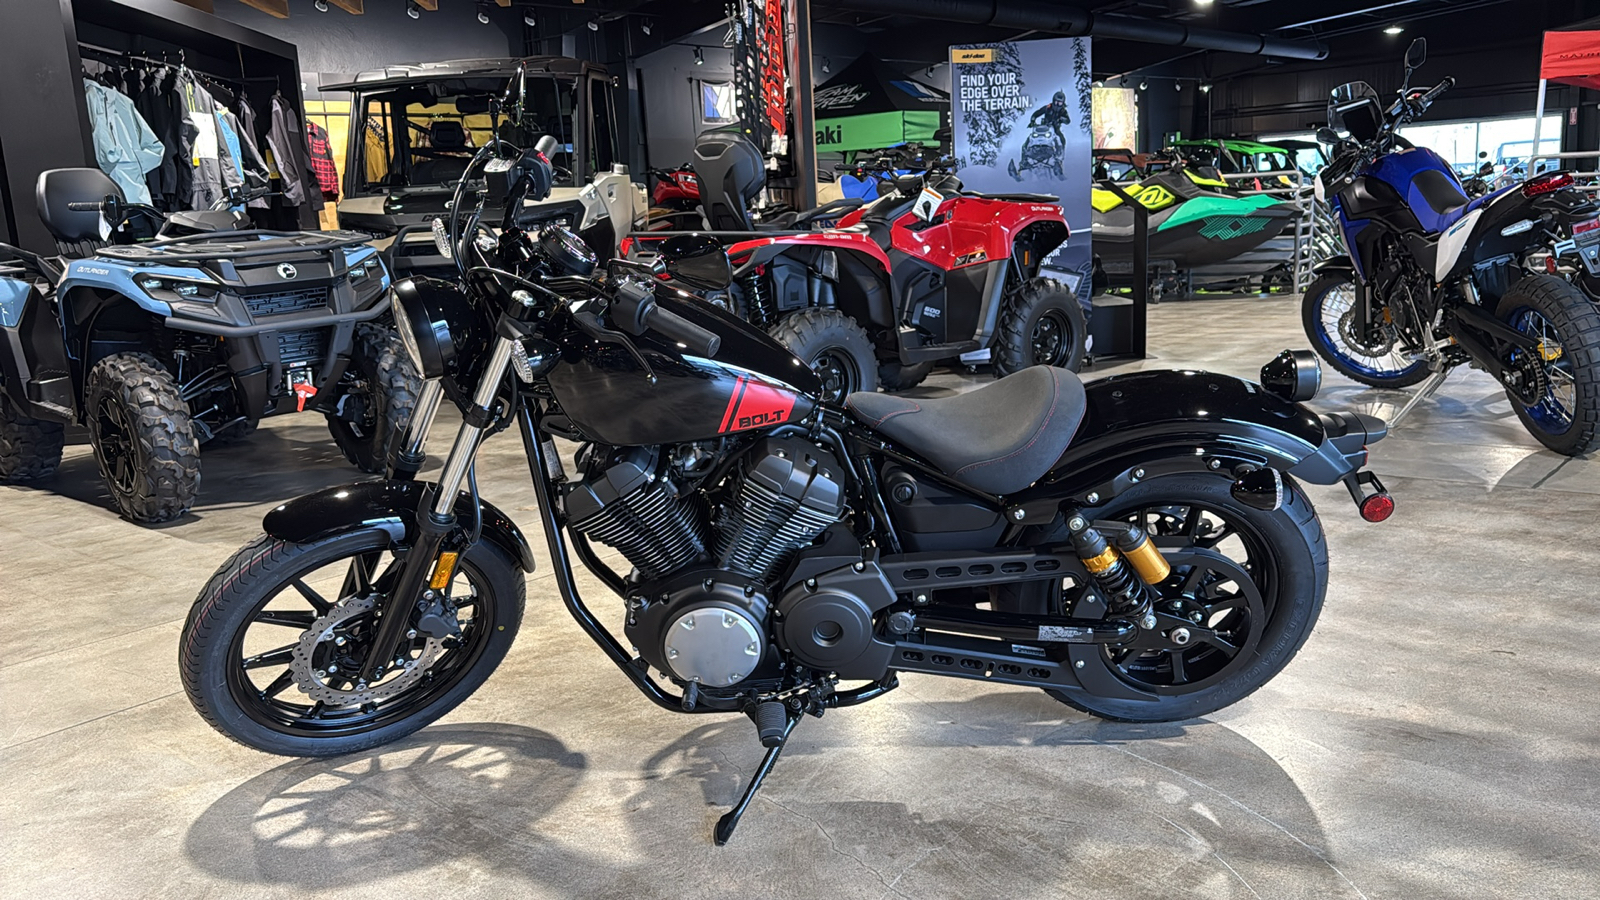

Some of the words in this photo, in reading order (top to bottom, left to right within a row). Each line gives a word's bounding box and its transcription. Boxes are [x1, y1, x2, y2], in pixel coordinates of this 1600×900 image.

[960, 75, 985, 87] FIND
[987, 72, 1016, 86] YOUR
[960, 87, 988, 99] EDGE
[991, 84, 1019, 98] OVER
[961, 99, 981, 112] THE
[983, 95, 1032, 110] TERRAIN.
[77, 266, 109, 275] OUTLANDER
[739, 410, 784, 428] BOLT
